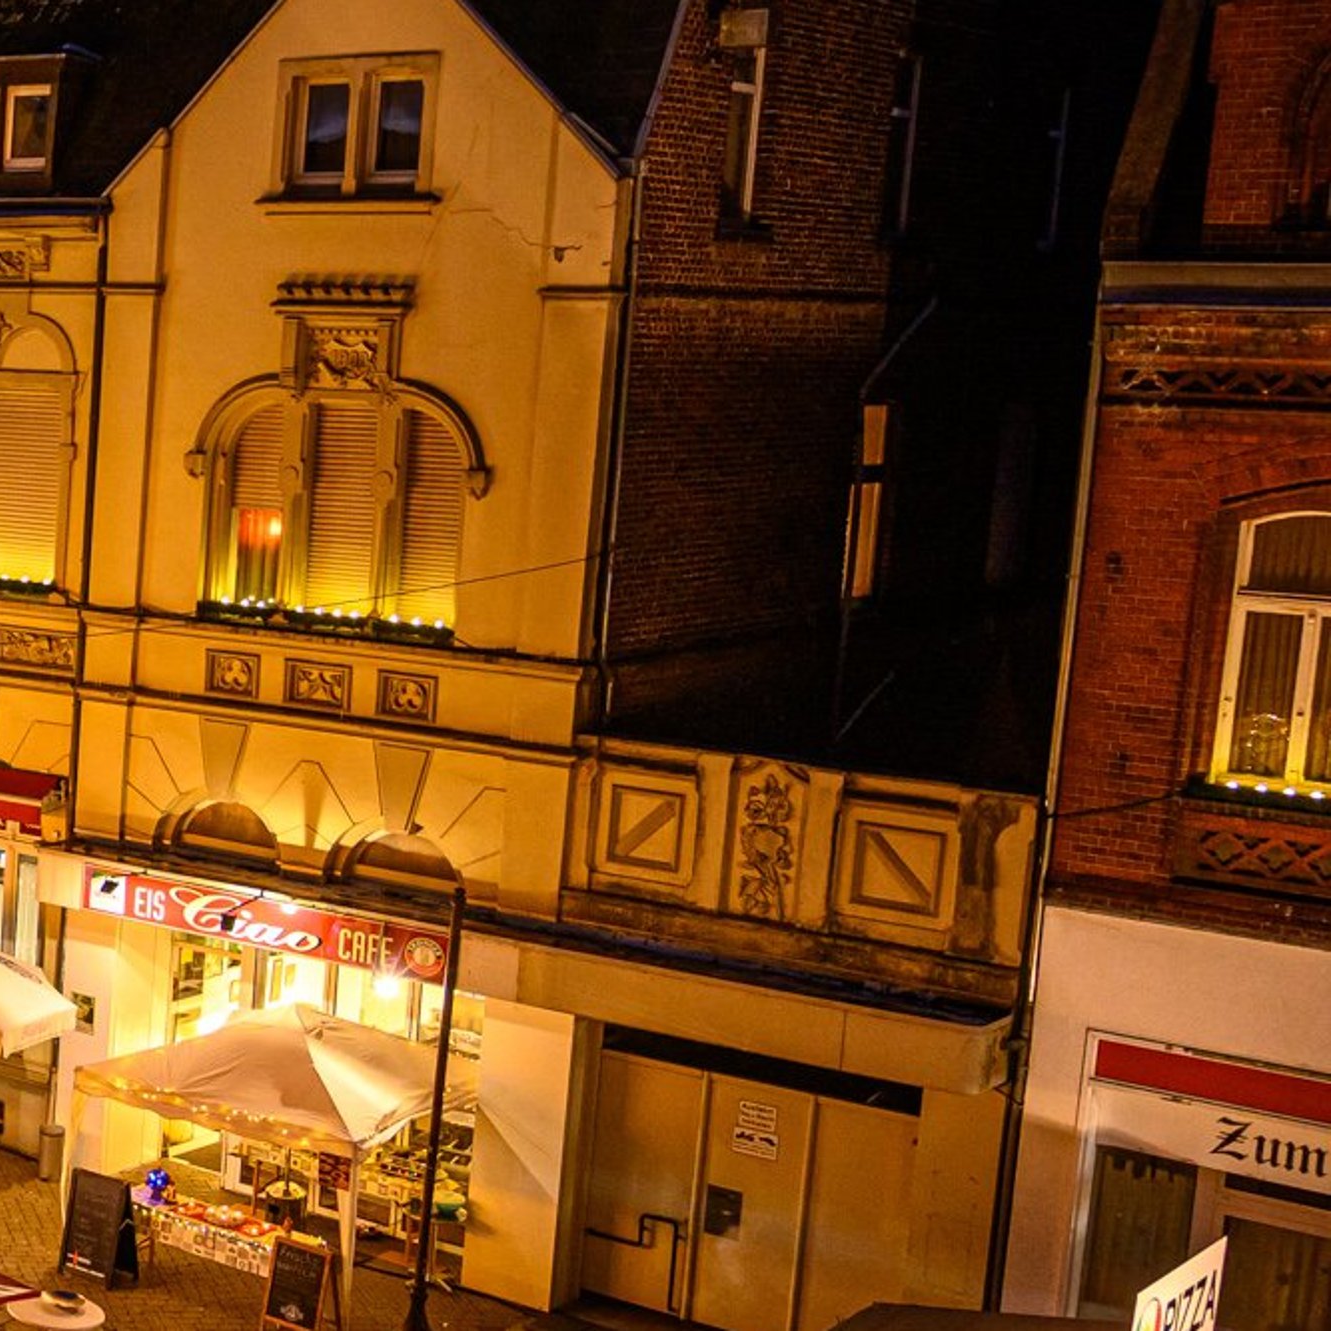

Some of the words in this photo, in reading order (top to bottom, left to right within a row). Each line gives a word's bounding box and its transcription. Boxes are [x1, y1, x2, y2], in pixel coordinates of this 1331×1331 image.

[133, 885, 166, 922] EIS
[168, 887, 323, 951] Ciao
[1209, 1117, 1328, 1178] Zum
[1163, 1269, 1218, 1331] PIZZA
